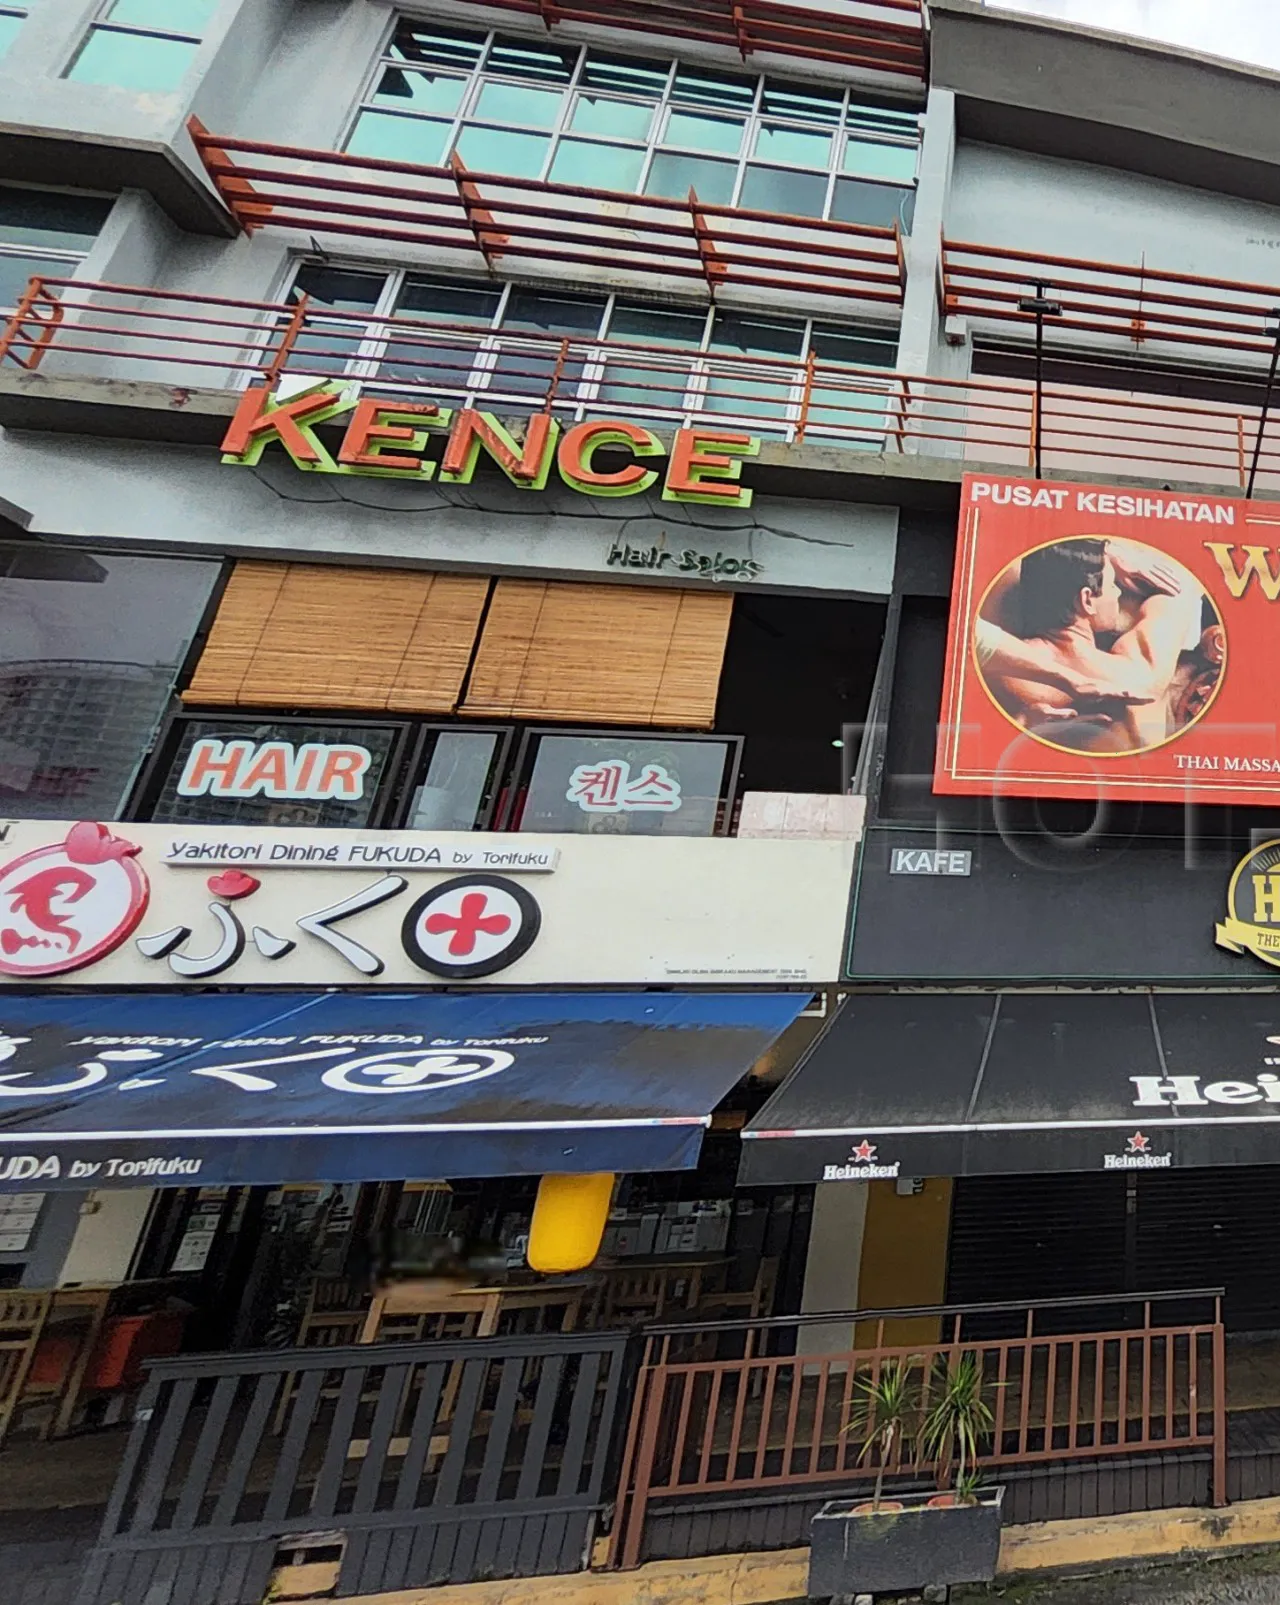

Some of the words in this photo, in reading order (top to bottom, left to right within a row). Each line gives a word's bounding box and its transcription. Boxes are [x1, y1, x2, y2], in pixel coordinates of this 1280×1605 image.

[220, 382, 761, 508] KENCE
[970, 482, 1068, 510] PUSAT
[1076, 490, 1235, 526] KESIHATAN
[606, 543, 673, 570] Hair
[180, 741, 369, 798] HAIR
[1174, 754, 1220, 771] THAI
[269, 844, 339, 862] Dining
[347, 845, 442, 864] FUKUDA
[452, 852, 472, 865] by
[483, 850, 549, 866] Torifuku
[896, 850, 966, 875] KAFE
[1257, 932, 1280, 948] THE
[68, 1159, 102, 1179] by
[104, 1157, 203, 1178] Torifuku
[823, 1162, 900, 1180] Heineken
[1103, 1152, 1172, 1169] Heineken
